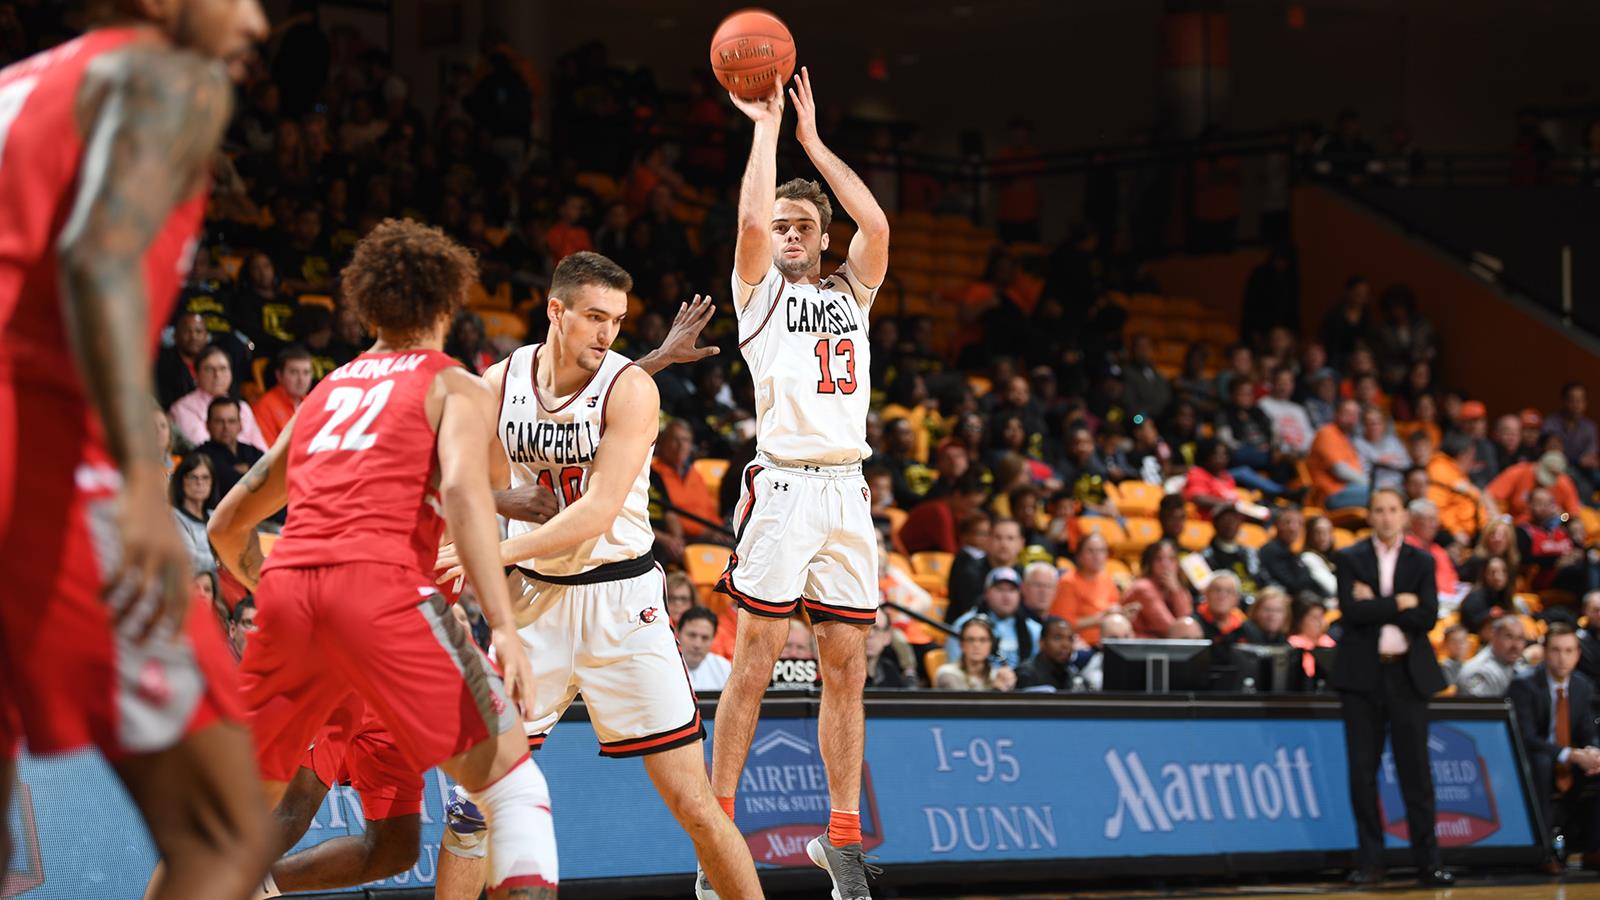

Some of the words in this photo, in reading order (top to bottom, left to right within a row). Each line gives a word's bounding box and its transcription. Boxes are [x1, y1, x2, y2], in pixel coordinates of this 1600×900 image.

[814, 338, 857, 395] 13
[306, 379, 395, 455] 22
[505, 421, 598, 464] CAMPBELL
[739, 764, 827, 794] AIRFIE
[930, 727, 1021, 783] I-95
[1104, 745, 1321, 839] Marriott
[923, 806, 1058, 853] DUNN
